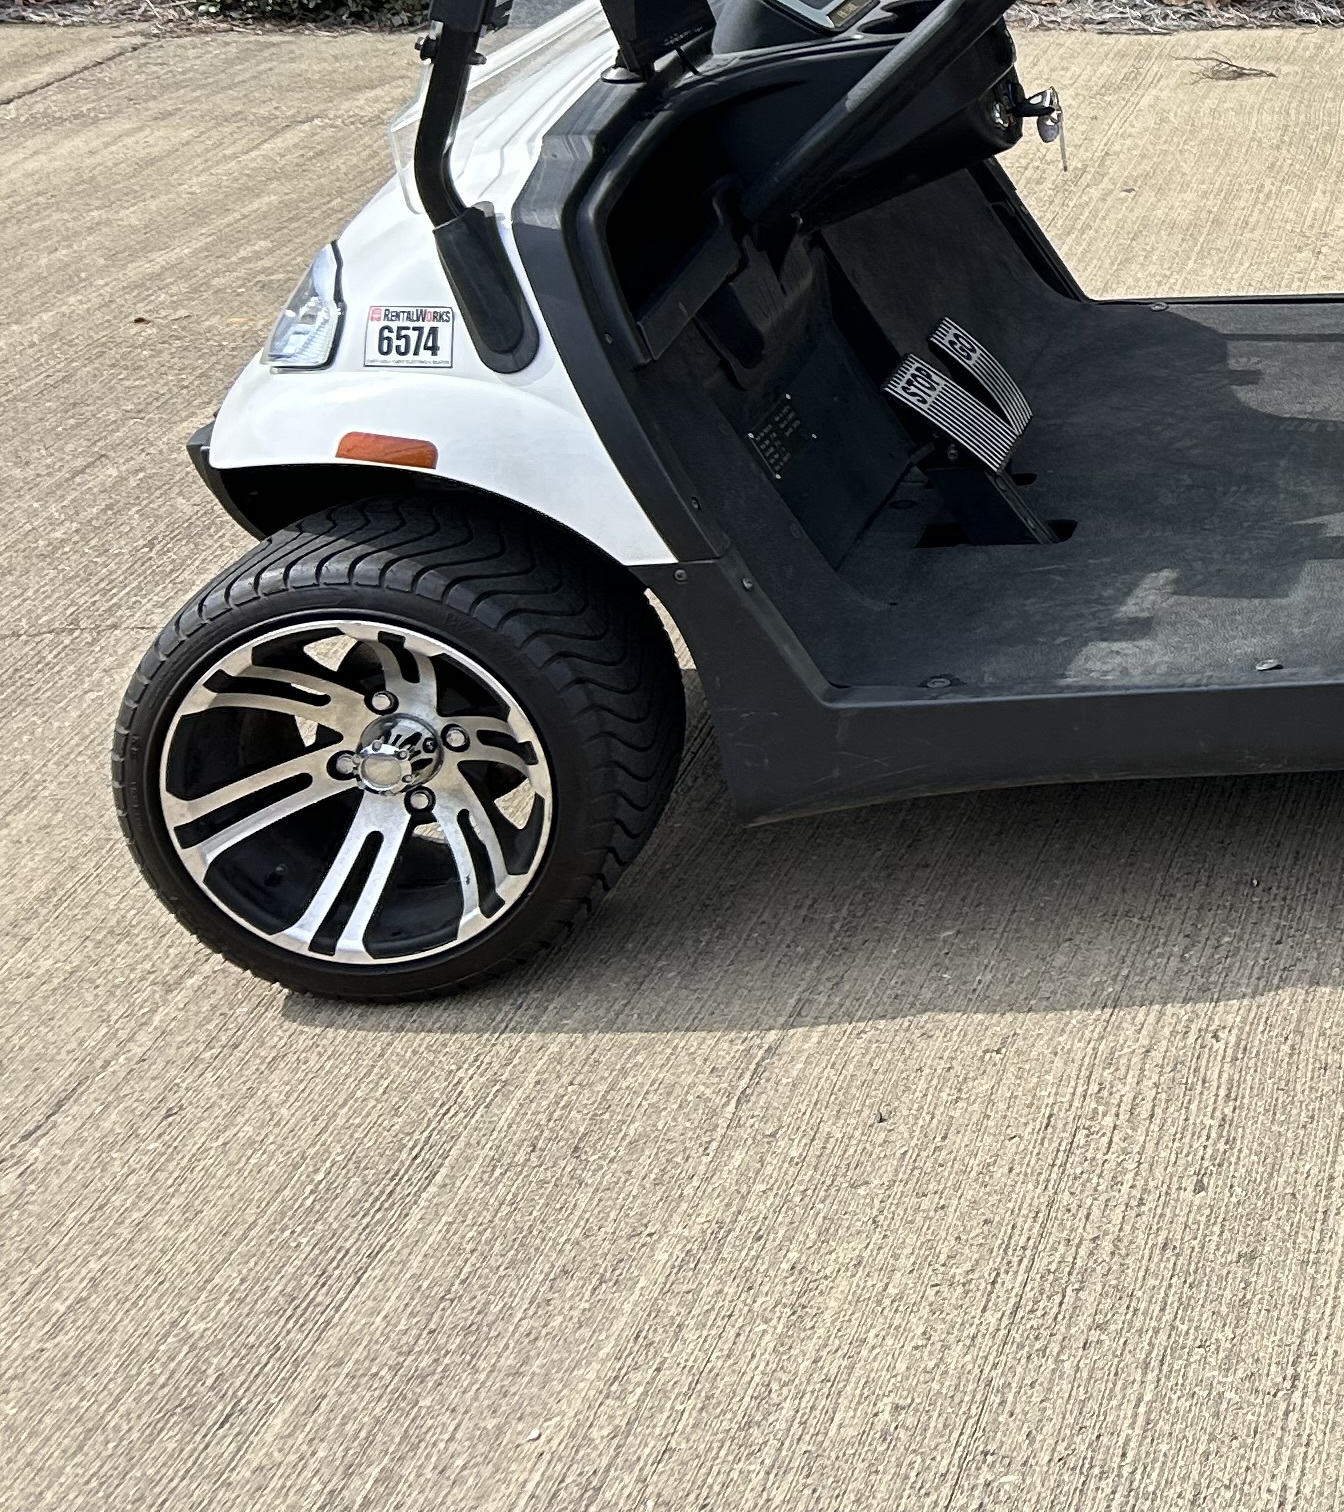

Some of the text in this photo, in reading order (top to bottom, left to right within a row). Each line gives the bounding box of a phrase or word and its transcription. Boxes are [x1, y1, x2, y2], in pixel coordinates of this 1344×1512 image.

[377, 324, 440, 357] 6574
[947, 332, 977, 361] GO
[901, 366, 940, 405] STOP
